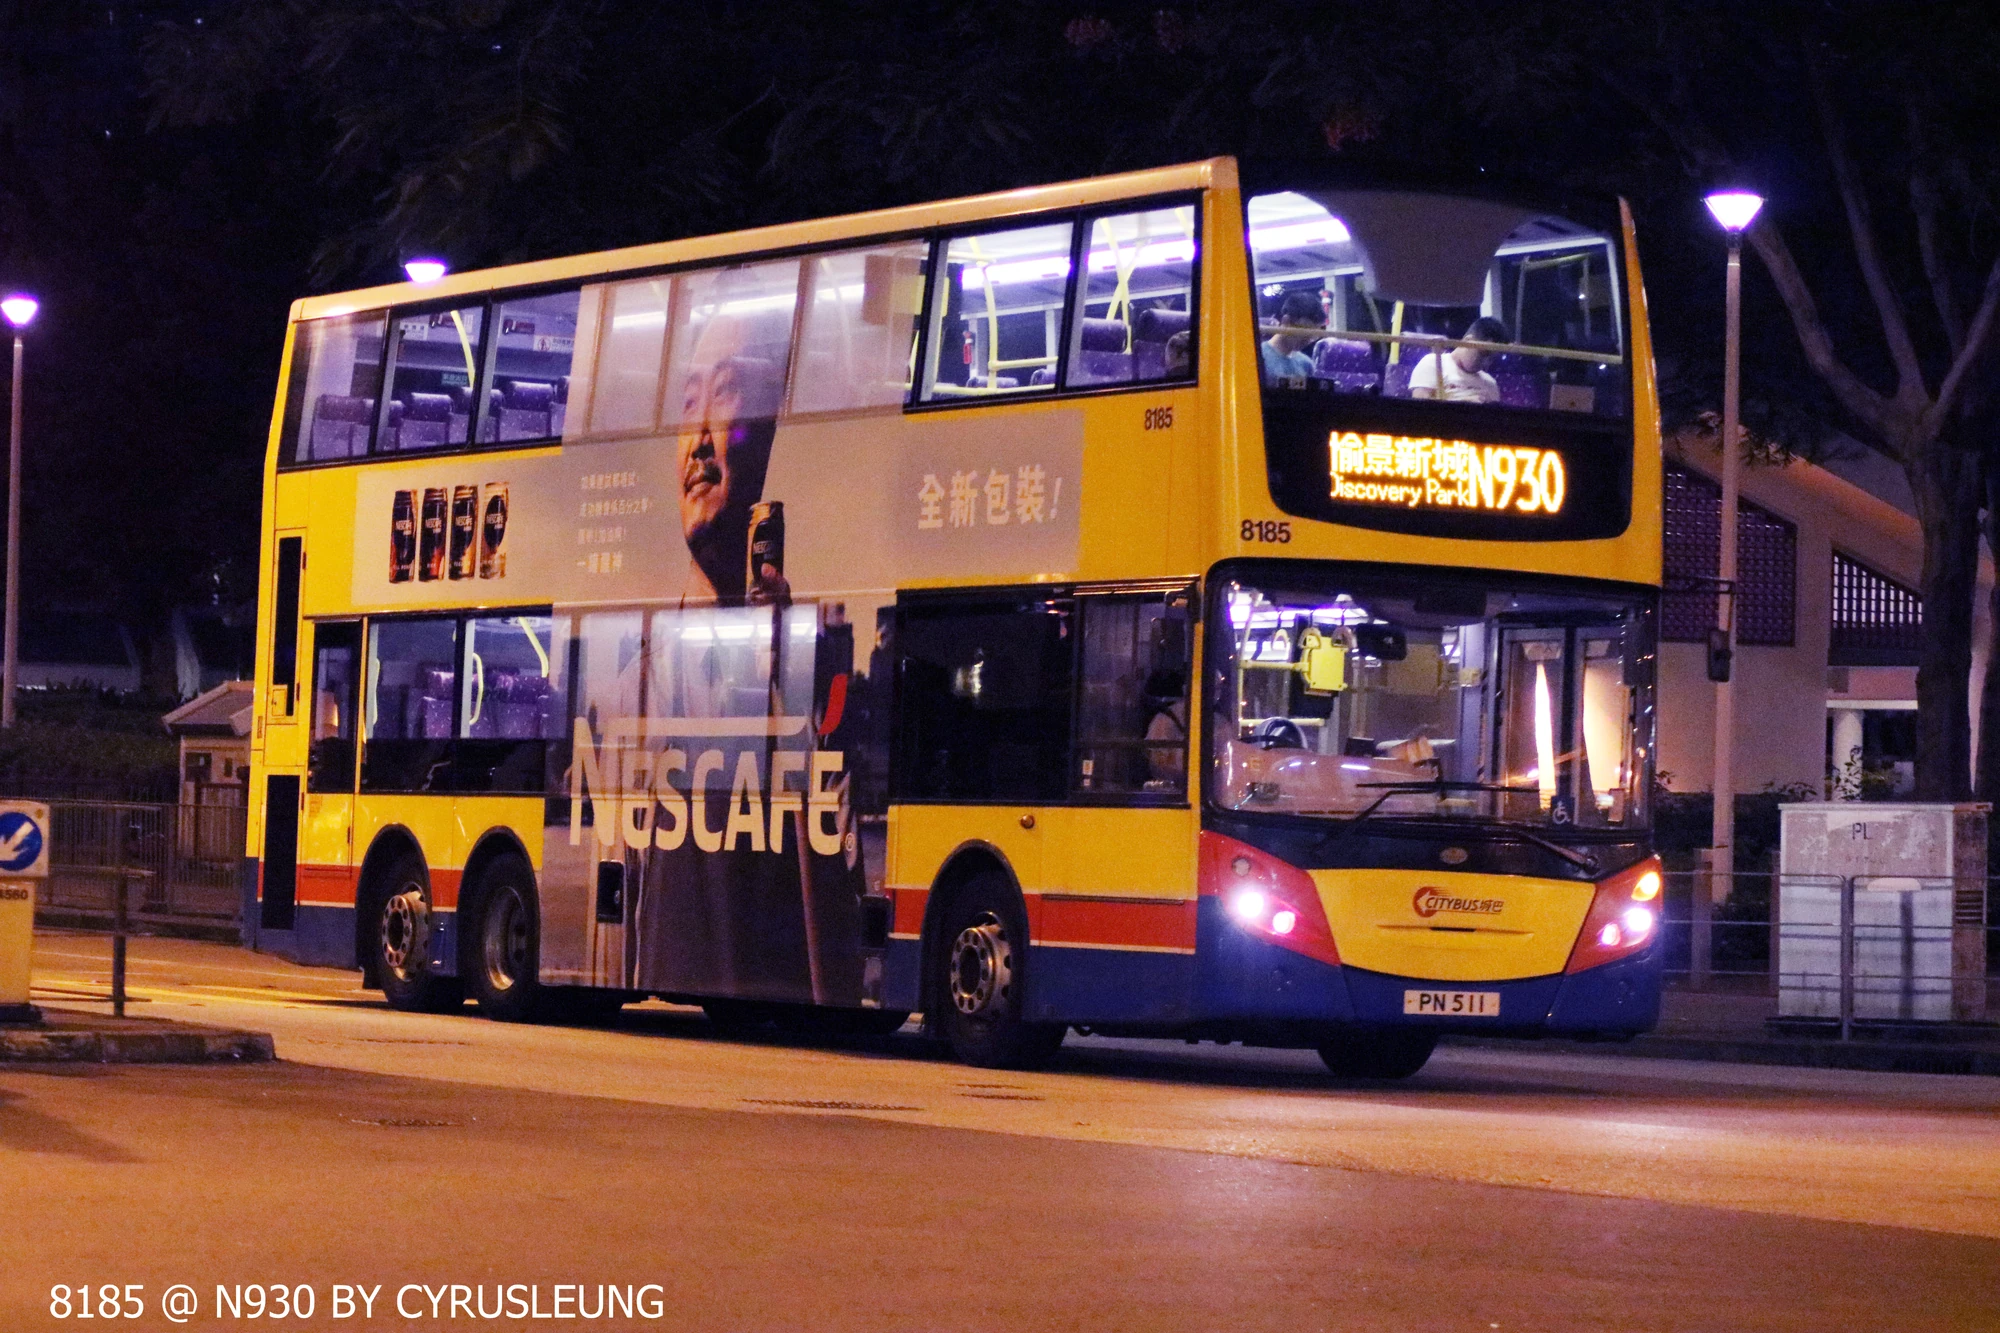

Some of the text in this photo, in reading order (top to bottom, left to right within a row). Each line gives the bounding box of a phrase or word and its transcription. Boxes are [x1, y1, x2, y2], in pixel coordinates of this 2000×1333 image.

[1143, 407, 1173, 431] 8185
[1329, 431, 1470, 481] 愉景新城
[1467, 445, 1566, 513] N930
[1426, 478, 1470, 506] Park
[1240, 519, 1292, 544] 8185
[1852, 822, 1872, 840] PL
[1425, 896, 1479, 912] CITYBUS
[1419, 993, 1484, 1013] PN 511
